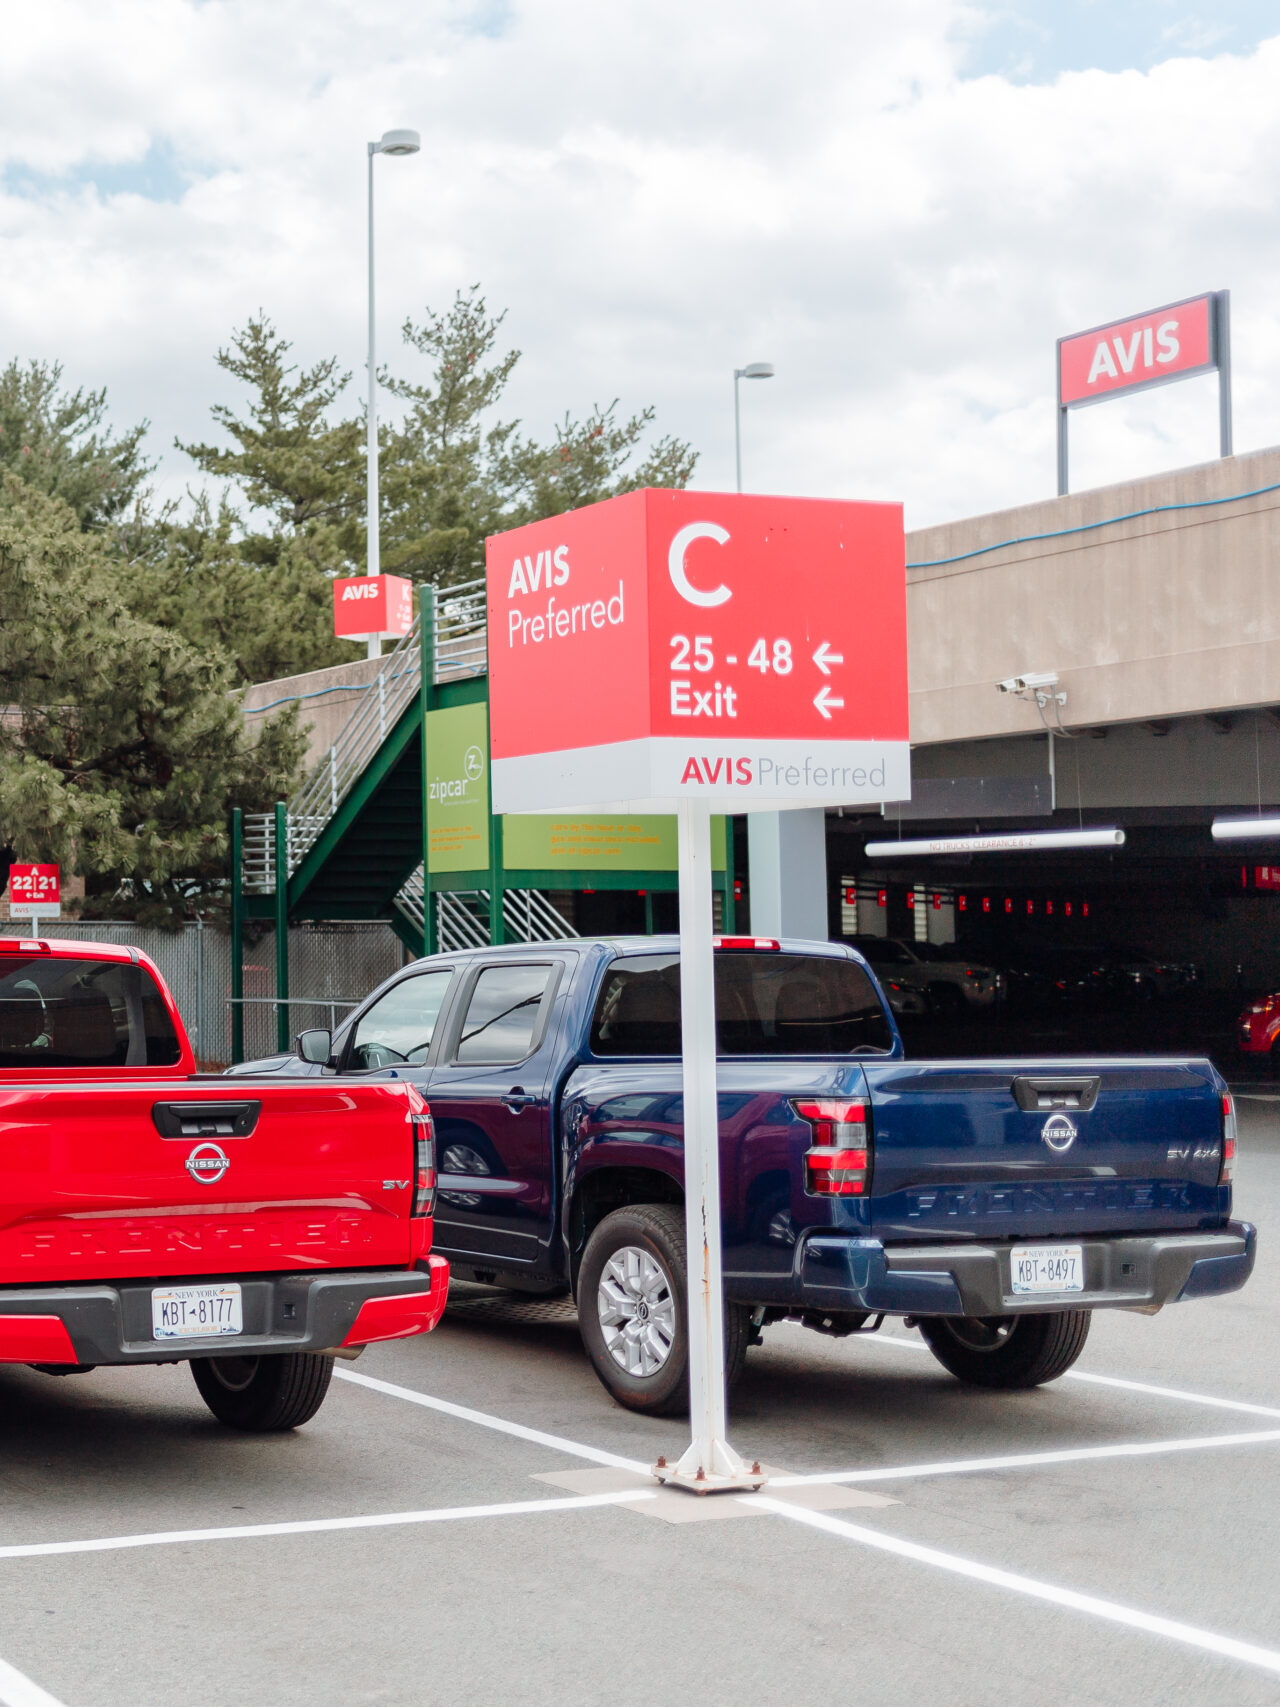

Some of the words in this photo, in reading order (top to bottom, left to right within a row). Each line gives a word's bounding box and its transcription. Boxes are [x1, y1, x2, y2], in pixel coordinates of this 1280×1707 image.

[1087, 320, 1180, 384] AVIS
[507, 545, 570, 598] AVIS
[668, 521, 732, 607] C
[341, 583, 379, 601] AVIS
[401, 583, 411, 602] K
[508, 579, 625, 648] Preferred
[669, 635, 714, 672] 25
[747, 638, 794, 675] 48
[670, 681, 737, 718] Exit
[680, 756, 753, 786] AVIS
[758, 755, 886, 788] Preferred
[429, 776, 469, 804] zipcar
[30, 866, 39, 876] A
[12, 875, 33, 890] 22
[38, 875, 57, 890] 21
[1041, 1129, 1078, 1139] NISSAN
[1167, 1149, 1190, 1159] SV
[185, 1160, 230, 1169] NISSAN
[382, 1179, 410, 1190] SV
[175, 1290, 195, 1299] NEW
[196, 1289, 219, 1298] YORK
